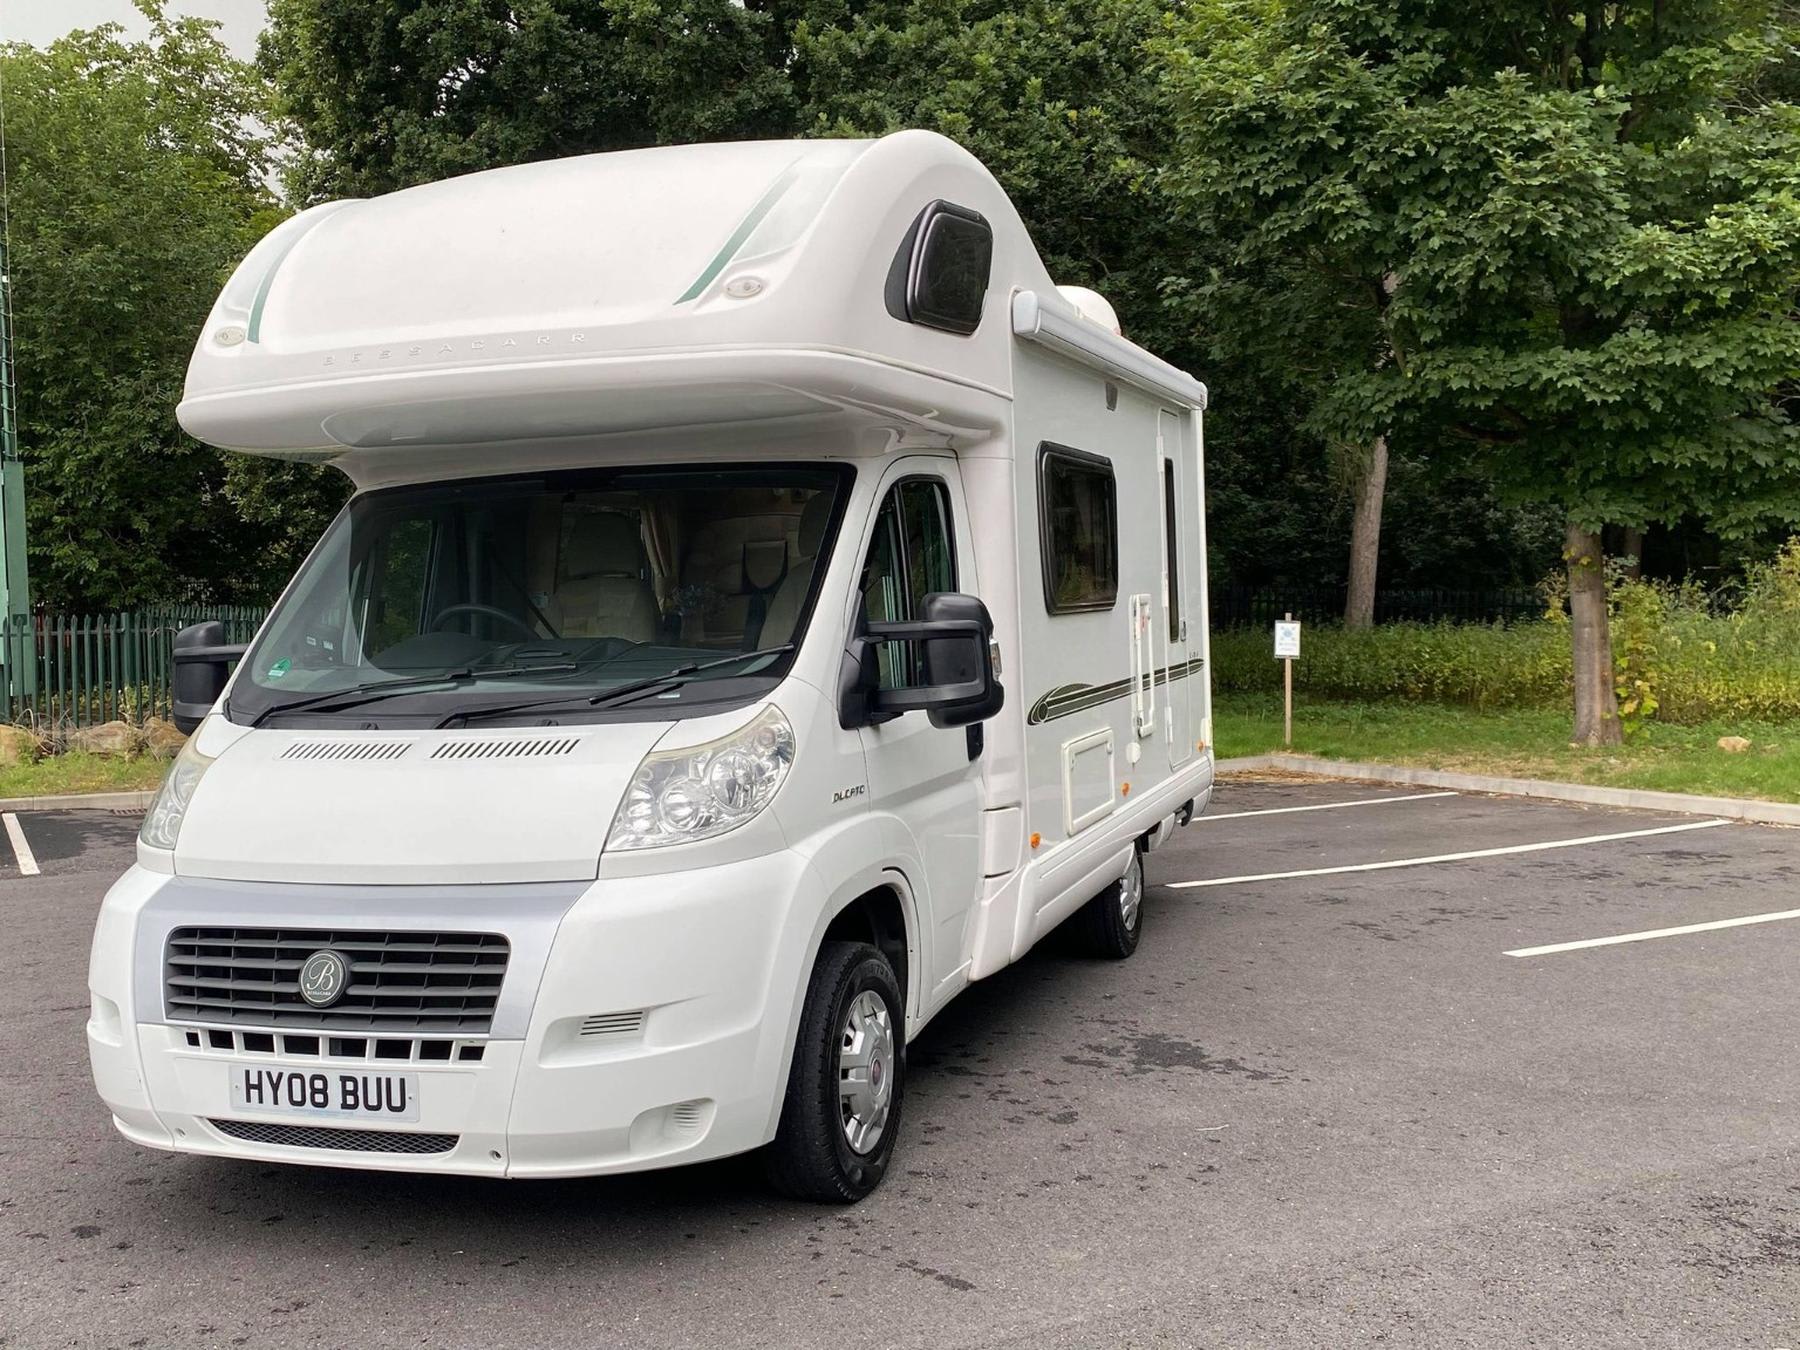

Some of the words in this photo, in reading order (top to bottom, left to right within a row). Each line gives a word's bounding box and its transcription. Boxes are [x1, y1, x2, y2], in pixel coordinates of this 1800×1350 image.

[306, 959, 335, 991] B
[244, 1069, 329, 1109] HY08
[339, 1075, 407, 1113] BUU
